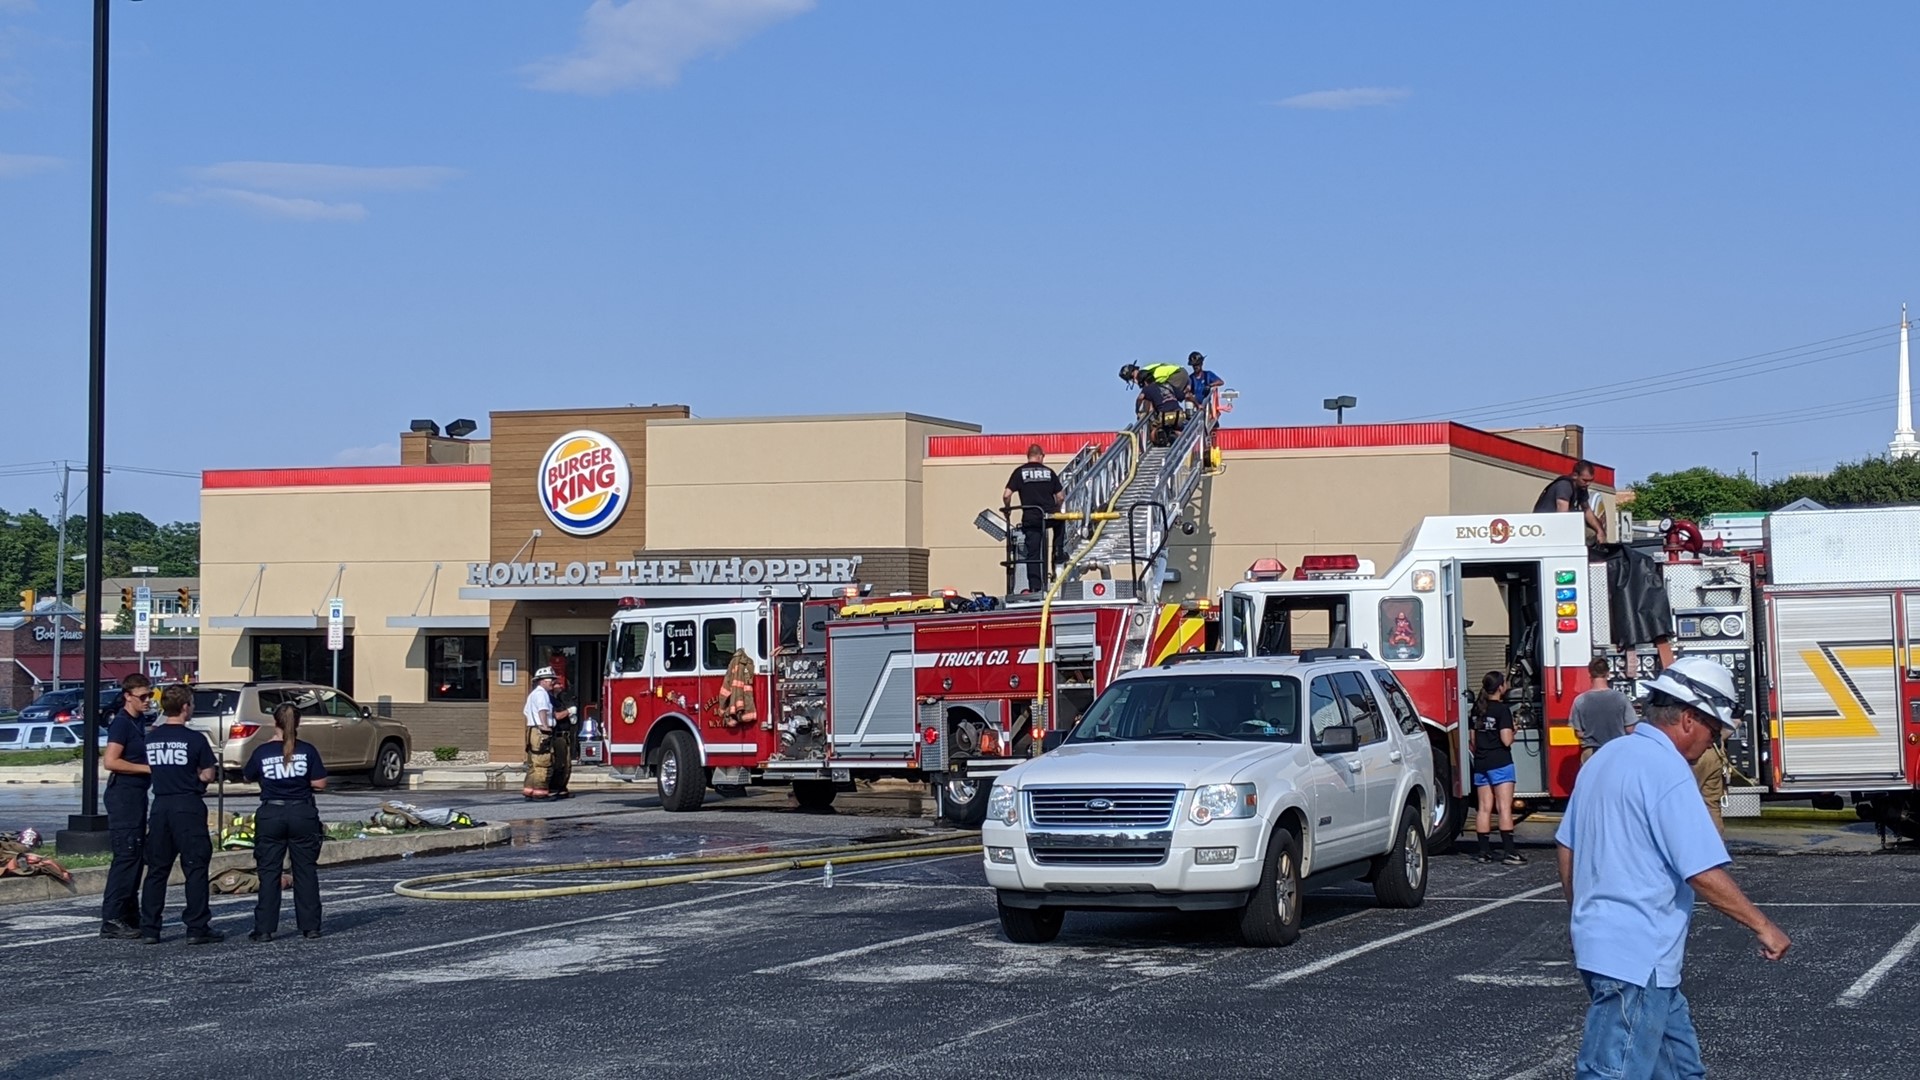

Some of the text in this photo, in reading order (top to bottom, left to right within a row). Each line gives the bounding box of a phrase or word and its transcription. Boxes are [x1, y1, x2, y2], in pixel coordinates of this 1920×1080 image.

[548, 447, 612, 486] BURGER
[1022, 470, 1052, 480] FIRE
[552, 463, 616, 511] KING
[1456, 525, 1546, 539] ENGINE CO.
[1490, 518, 1510, 544] 9
[466, 556, 854, 586] HOME OF THE WHOPPER
[33, 626, 56, 641] Bob
[666, 624, 694, 638] Truck
[669, 640, 691, 658] 1-1
[939, 649, 1025, 667] TRUCK CO. 1
[145, 741, 188, 750] WEST YORK
[146, 749, 188, 766] EMS
[261, 755, 284, 765] WEST
[262, 761, 308, 780] EMS
